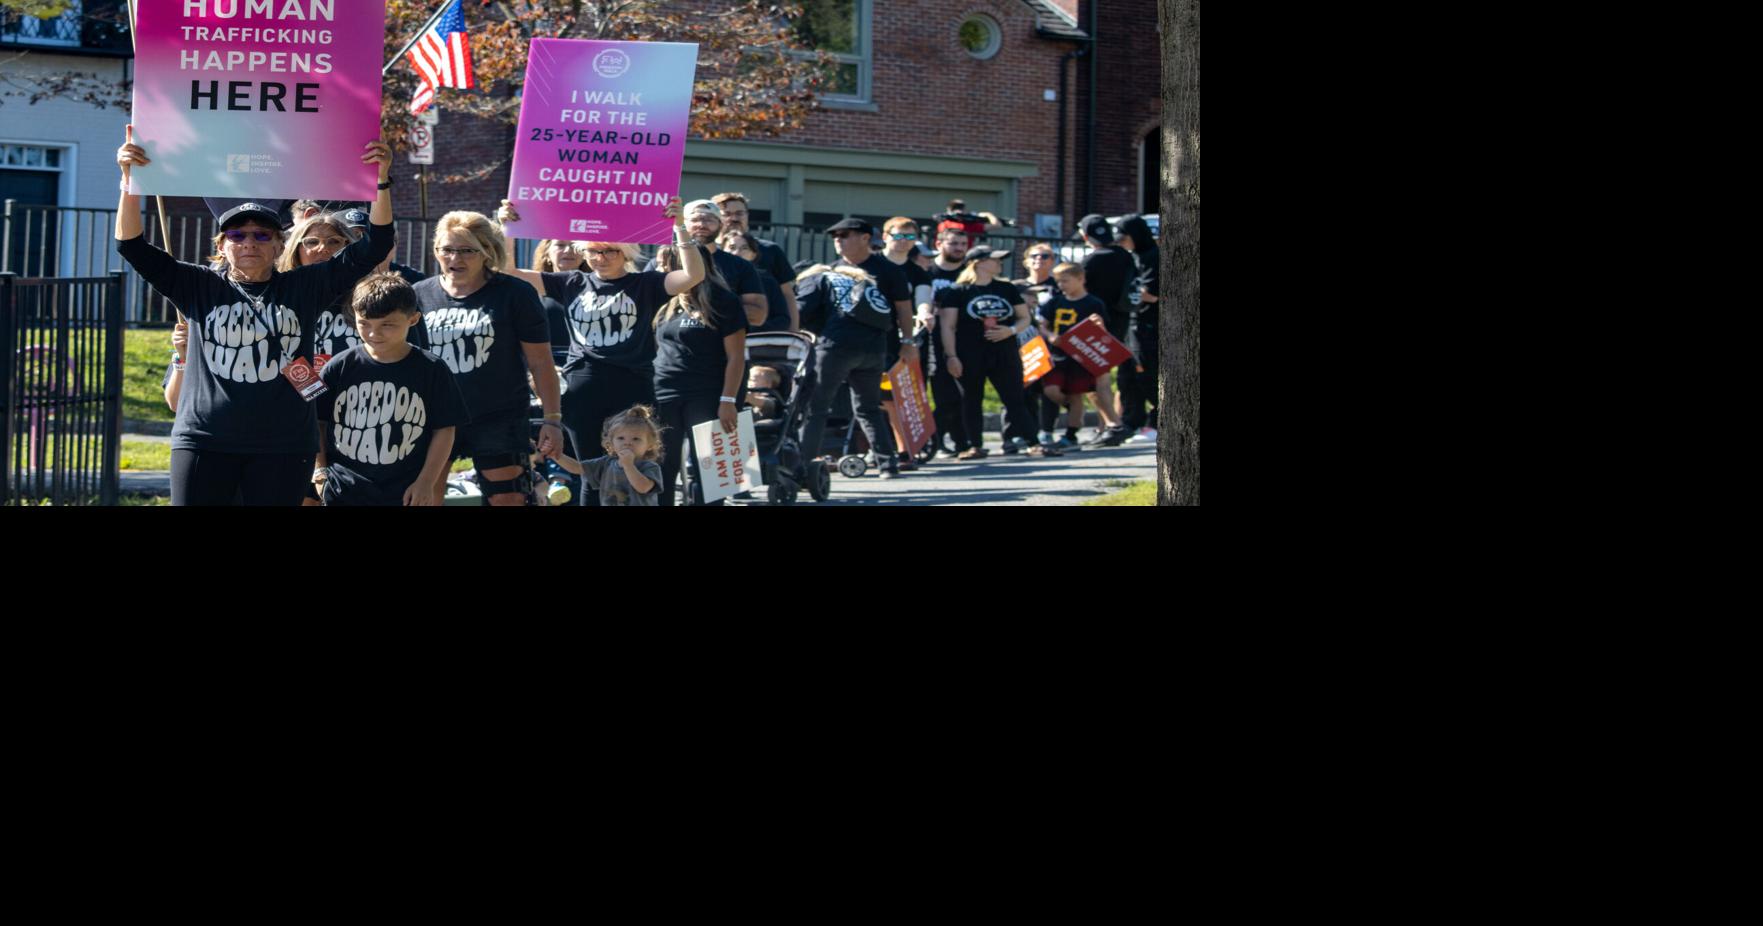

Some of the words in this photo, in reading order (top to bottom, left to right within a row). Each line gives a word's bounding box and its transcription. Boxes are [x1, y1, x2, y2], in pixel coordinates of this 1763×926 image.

[183, 0, 335, 21] HUMAN
[181, 26, 333, 44] TRAFFICKING
[180, 50, 333, 74] HAPPENS
[190, 80, 320, 112] HERE
[571, 90, 577, 103] I
[584, 91, 642, 105] WALK
[560, 109, 600, 124] FOR
[607, 111, 648, 126] THE
[531, 128, 670, 146] 25-YEAR-OLD
[557, 149, 639, 165] WOMAN
[540, 168, 624, 185] CAUGHT
[630, 171, 653, 186] IN
[1053, 308, 1078, 336] P
[1069, 335, 1110, 367] WORTHY
[1091, 341, 1110, 354] AM
[203, 336, 301, 383] WALK
[333, 381, 427, 430] FREEDOM
[333, 422, 425, 466] WALK
[711, 431, 725, 457] NOT
[716, 460, 728, 478] AM
[732, 459, 745, 485] FOR
